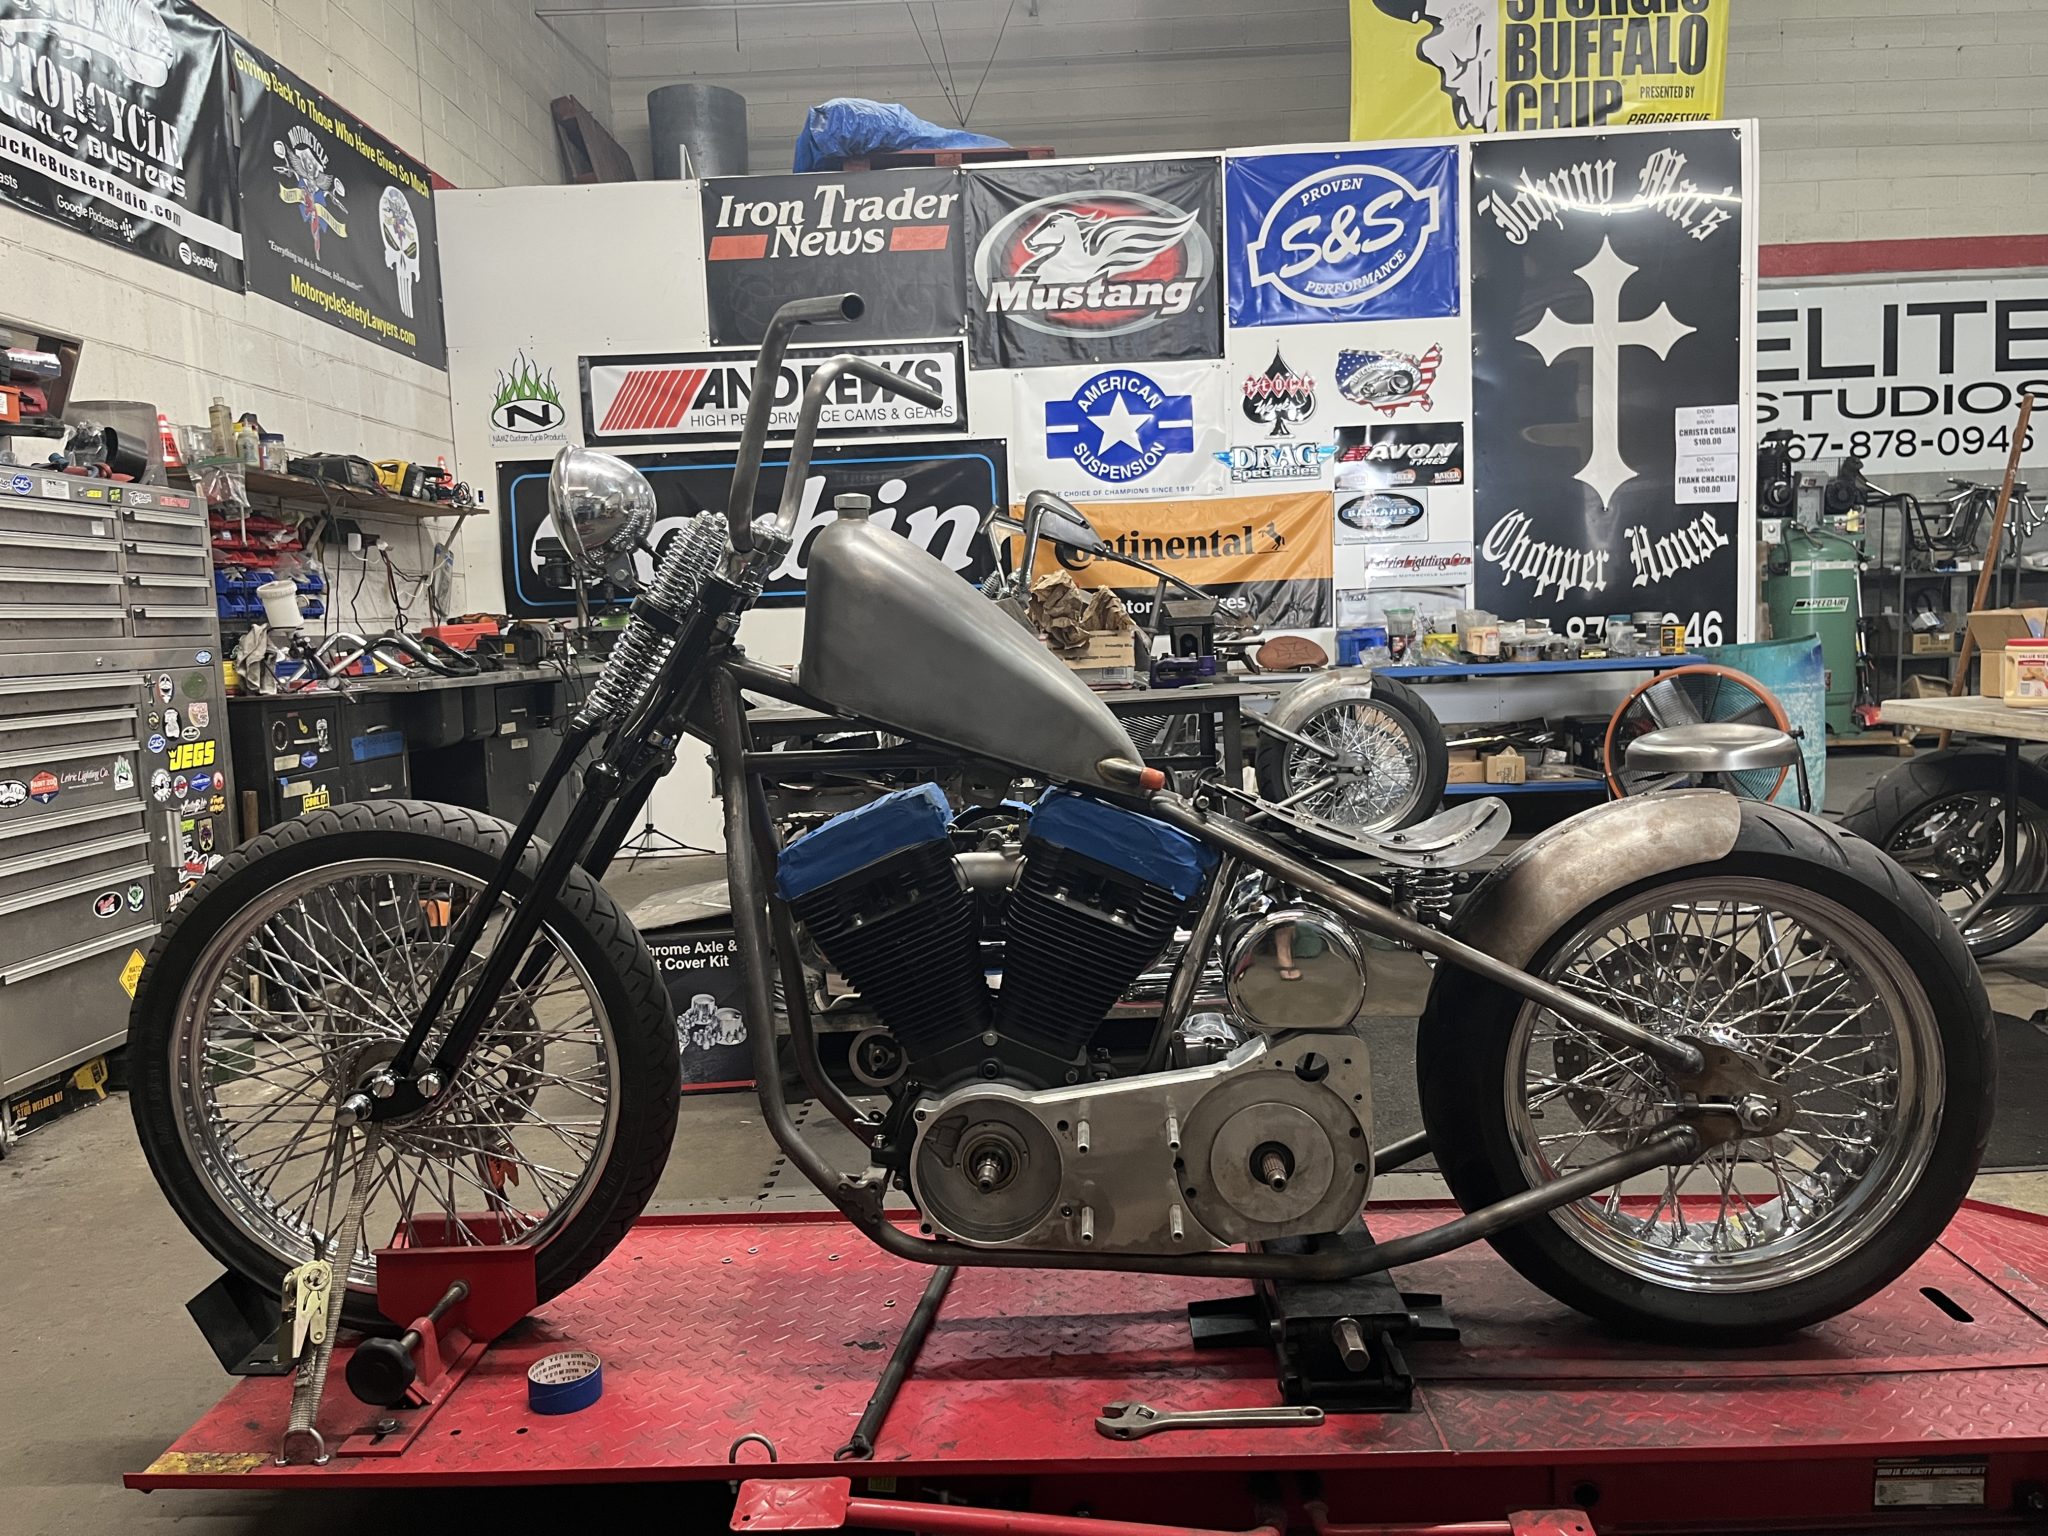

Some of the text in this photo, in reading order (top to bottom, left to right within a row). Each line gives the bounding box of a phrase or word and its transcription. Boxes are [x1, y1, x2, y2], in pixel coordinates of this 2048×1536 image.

[1505, 14, 1709, 82] BUFFALO
[1505, 80, 1624, 132] CHIP
[1640, 85, 1695, 99] PRESENTED BY
[234, 50, 430, 199] Giving Back To Those Who Have Given So Much
[287, 125, 330, 169] MOTORCYCLE
[716, 184, 959, 229] Iron Trader
[1300, 177, 1363, 207] PROVEN
[1477, 159, 1617, 245] Johnny
[57, 194, 119, 231] Google Podcasts
[770, 225, 885, 259] News
[1279, 190, 1405, 279] S&S
[191, 251, 218, 273] Spotify
[1304, 249, 1407, 295] PERFORMANCE
[290, 274, 416, 347] MotorcycleSafetyLawyers.com
[986, 279, 1198, 315] Mustang
[1757, 300, 2048, 382] ELITE
[1077, 376, 1162, 413] AMERICAN
[691, 415, 728, 427] HIGH
[844, 409, 886, 421] CAMS
[891, 409, 900, 420] &
[904, 406, 953, 419] GEARS
[530, 434, 543, 443] Cycle
[544, 433, 567, 441] Products
[1679, 427, 1736, 437] CHRISTA COLGAN
[1693, 438, 1722, 446] $100.00
[1758, 424, 2034, 462] 67-878-0946
[1074, 441, 1166, 479] SUSPENSION
[1231, 442, 1319, 469] DRAG
[1366, 441, 1458, 460] AVON
[1409, 457, 1448, 466] TYRES
[1232, 465, 1319, 481] Specialties
[1434, 471, 1460, 480] BAKER
[1678, 475, 1736, 484] FRANK CHACKLER
[1104, 488, 1149, 496] CHAMPIONS
[1693, 485, 1721, 494] $100.00
[1347, 506, 1416, 518] BADLANDS
[1482, 508, 1729, 603] Chopper House
[169, 741, 215, 771] JEGS
[305, 796, 319, 808] COOL
[647, 939, 738, 957] hrome Axle &
[664, 957, 707, 971] Cover
[710, 954, 729, 968] Kit
